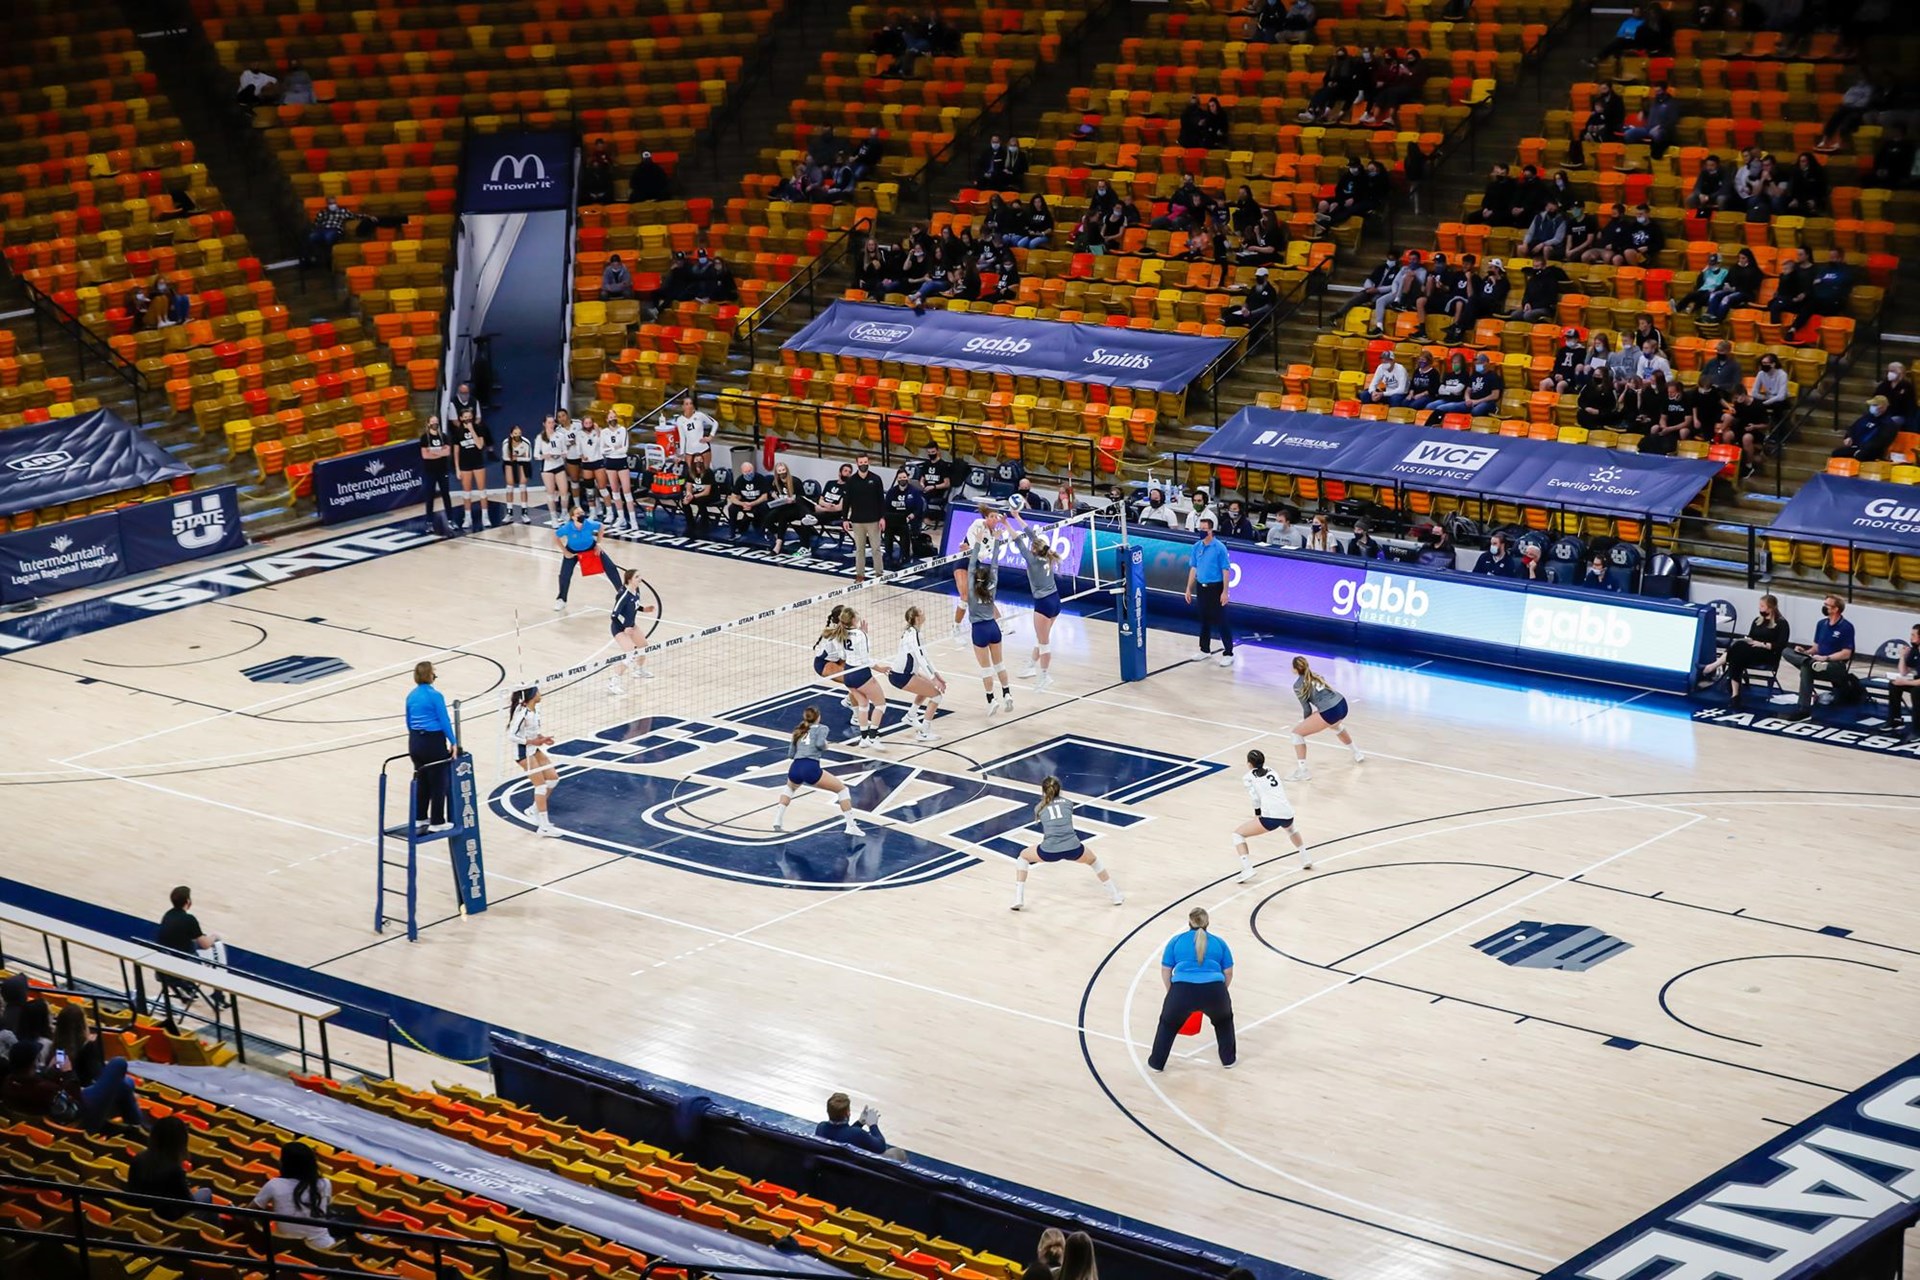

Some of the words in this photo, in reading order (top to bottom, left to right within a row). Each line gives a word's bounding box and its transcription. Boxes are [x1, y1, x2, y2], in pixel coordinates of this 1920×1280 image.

[961, 336, 1032, 354] gabb
[686, 422, 695, 431] 21
[587, 438, 593, 446] 4
[1417, 444, 1489, 466] WCF
[337, 469, 411, 495] Intermountain
[1392, 464, 1475, 481] INSURANCE
[329, 494, 355, 506] Logan
[355, 485, 390, 500] Regional
[390, 476, 422, 492] Hospital
[1547, 478, 1603, 494] Everlight
[1605, 485, 1641, 497] Solar
[172, 508, 226, 536] STATE
[11, 571, 41, 586] Logan
[41, 563, 79, 580] Regional
[80, 553, 118, 570] Hospital
[19, 545, 105, 573] Intermountain
[107, 527, 442, 611] STATE
[1332, 575, 1430, 616] gabb
[1354, 609, 1418, 629] WIRELESS
[1525, 605, 1632, 646] gabb
[800, 731, 811, 745] 4
[1266, 774, 1279, 788] 3
[460, 779, 475, 829] UTAH
[1047, 804, 1063, 820] 11
[466, 838, 482, 899] STATE
